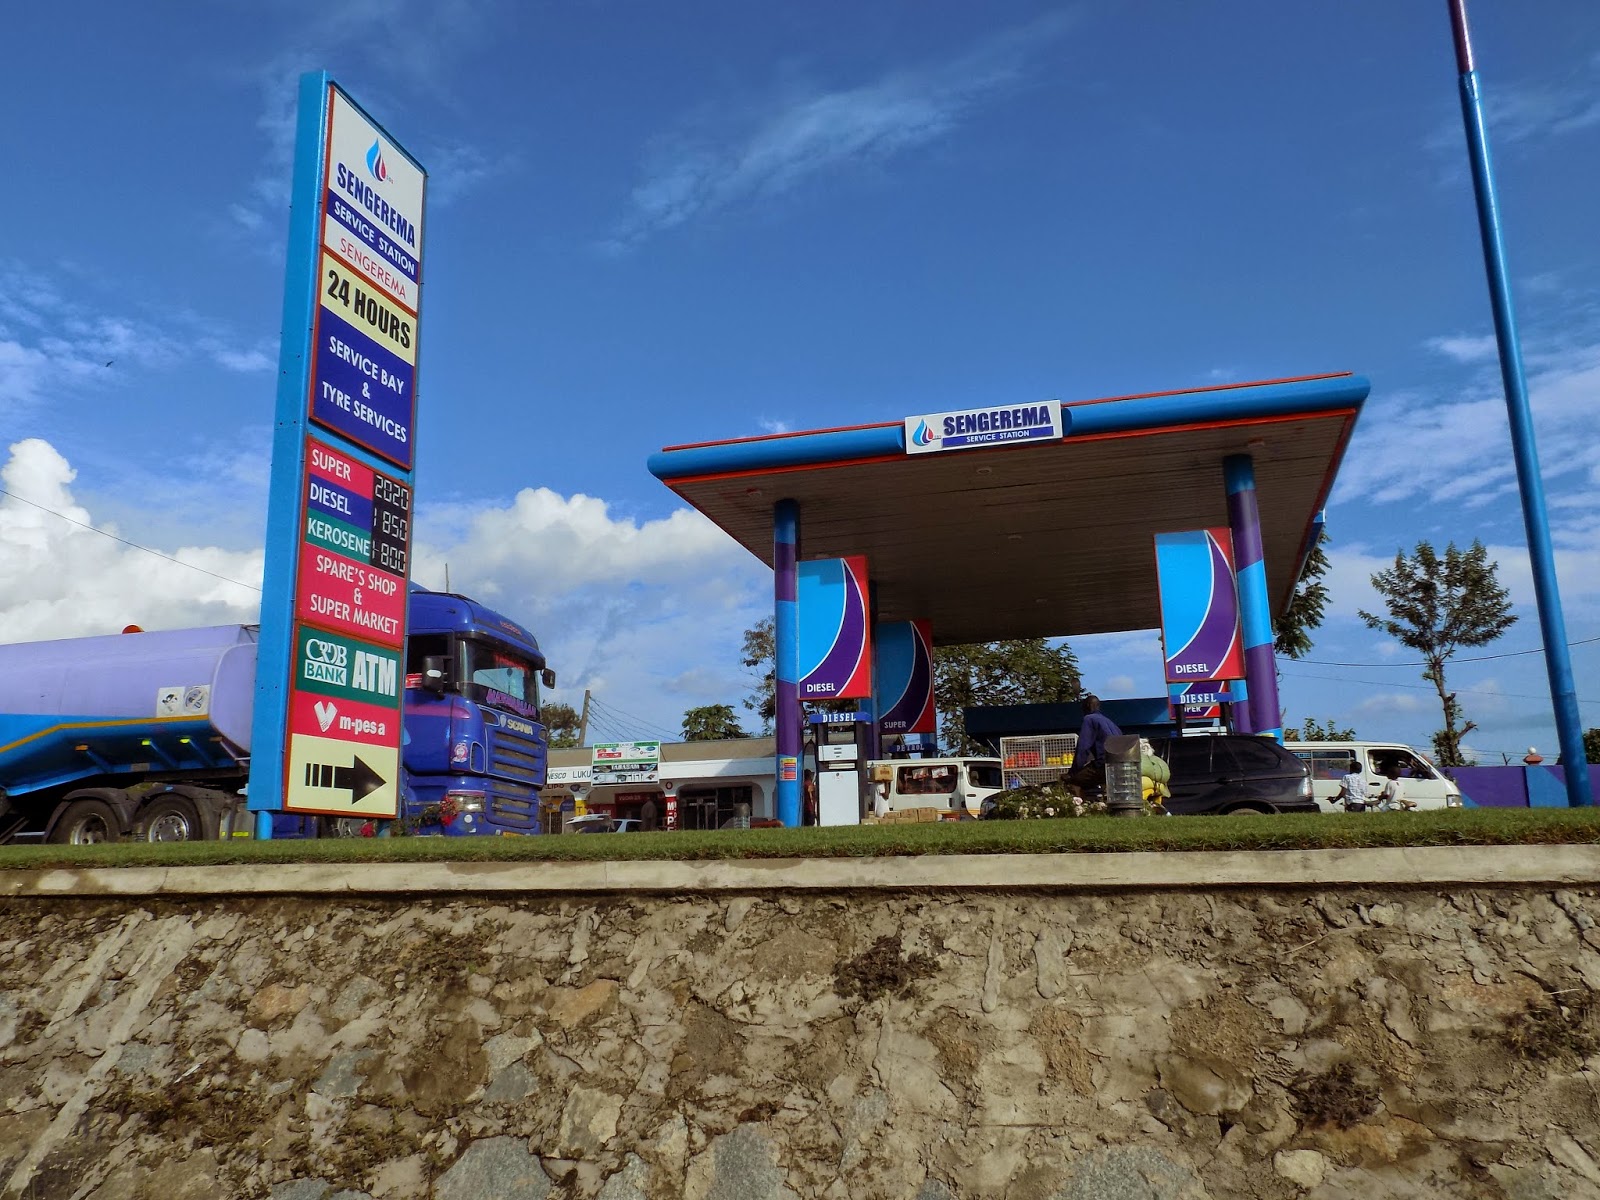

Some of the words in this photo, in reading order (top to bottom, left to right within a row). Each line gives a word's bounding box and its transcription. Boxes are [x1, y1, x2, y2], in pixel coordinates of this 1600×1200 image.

[337, 162, 415, 248] SENGEREMA
[334, 201, 374, 243] SERVICE
[379, 237, 415, 275] STATION
[340, 238, 406, 299] SENGEREMA
[327, 269, 350, 308] 24
[354, 288, 411, 349] HOURS
[329, 336, 378, 380] SERVICE
[381, 368, 404, 395] BAY
[362, 382, 370, 399] &
[322, 381, 350, 413] TYRE
[353, 400, 407, 443] SERVICES
[942, 405, 1052, 436] SENGEREMA
[966, 434, 996, 443] SERVICE
[1000, 430, 1029, 440] STATION
[311, 448, 352, 481] SUPER
[310, 483, 351, 516] DIESEL
[307, 517, 371, 557] KEROSENE
[316, 554, 365, 586] SPARE'S
[369, 573, 397, 597] SHOP
[354, 588, 362, 605] &
[310, 594, 350, 622] SUPER
[353, 608, 398, 636] MARKET
[305, 638, 347, 667] CRDB
[352, 650, 397, 697] ATM
[306, 664, 346, 685] BANK
[1175, 663, 1209, 674] DIESEL
[806, 682, 836, 693] DIESEL
[1180, 693, 1217, 704] DIESEL
[339, 715, 386, 736] m-pesa
[507, 719, 533, 735] SCANIA
[822, 713, 857, 723] DIESEL
[884, 721, 907, 729] SUPER
[896, 744, 925, 752] PETROL
[573, 770, 592, 779] LUKU
